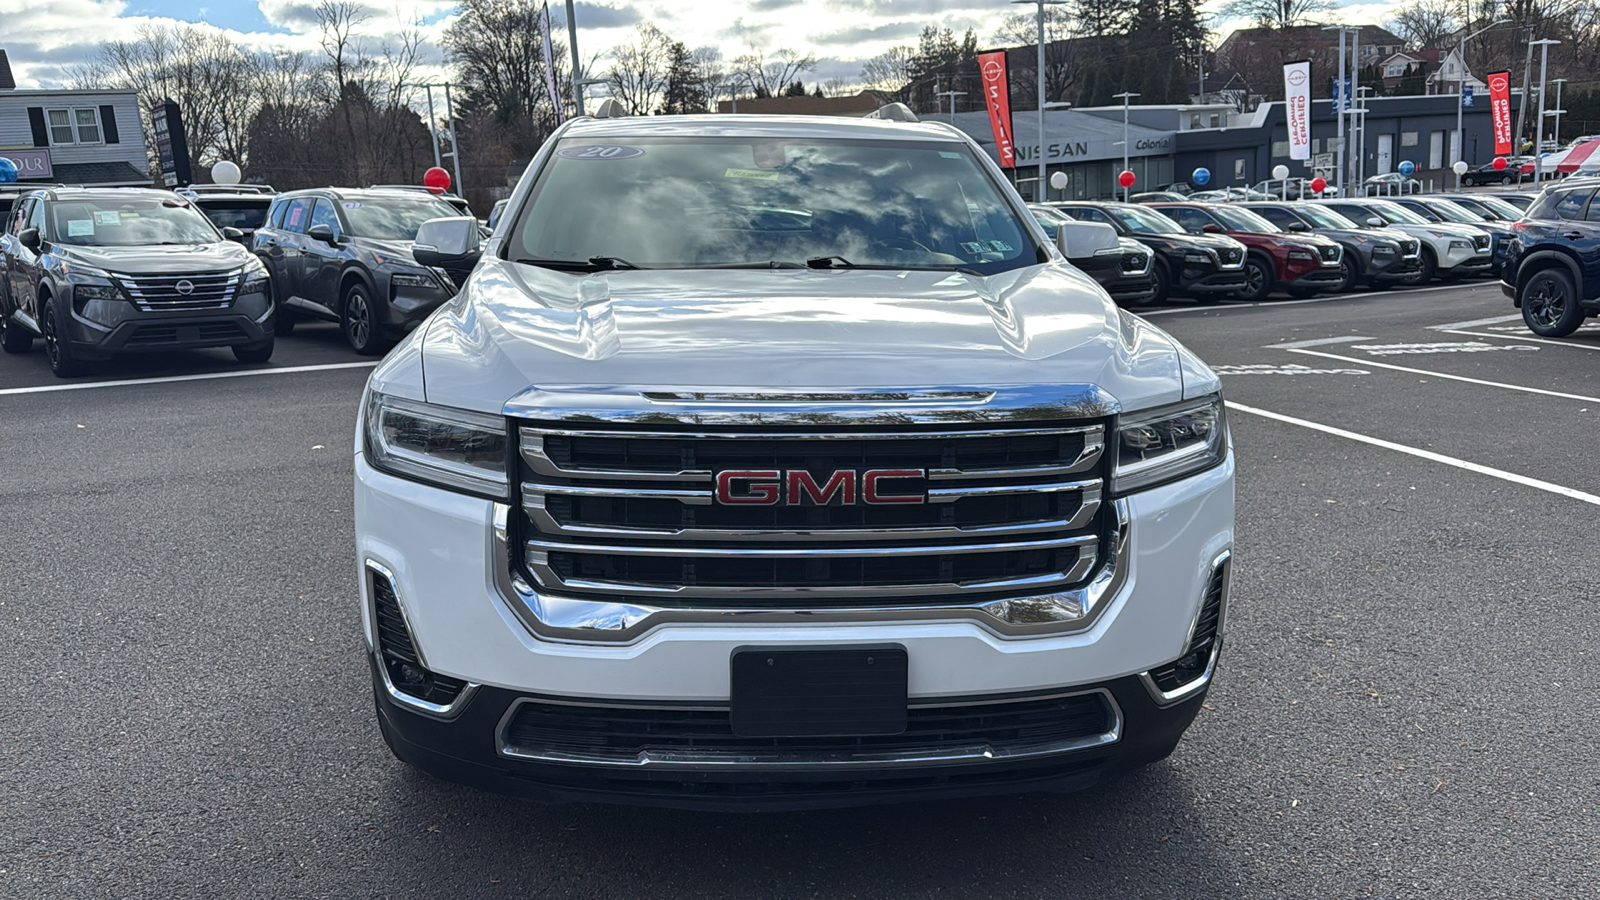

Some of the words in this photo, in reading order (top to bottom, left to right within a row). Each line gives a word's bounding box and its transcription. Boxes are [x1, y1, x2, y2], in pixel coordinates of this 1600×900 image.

[1135, 138, 1171, 150] Colonial
[578, 146, 623, 158] 20
[715, 469, 925, 506] GMC
